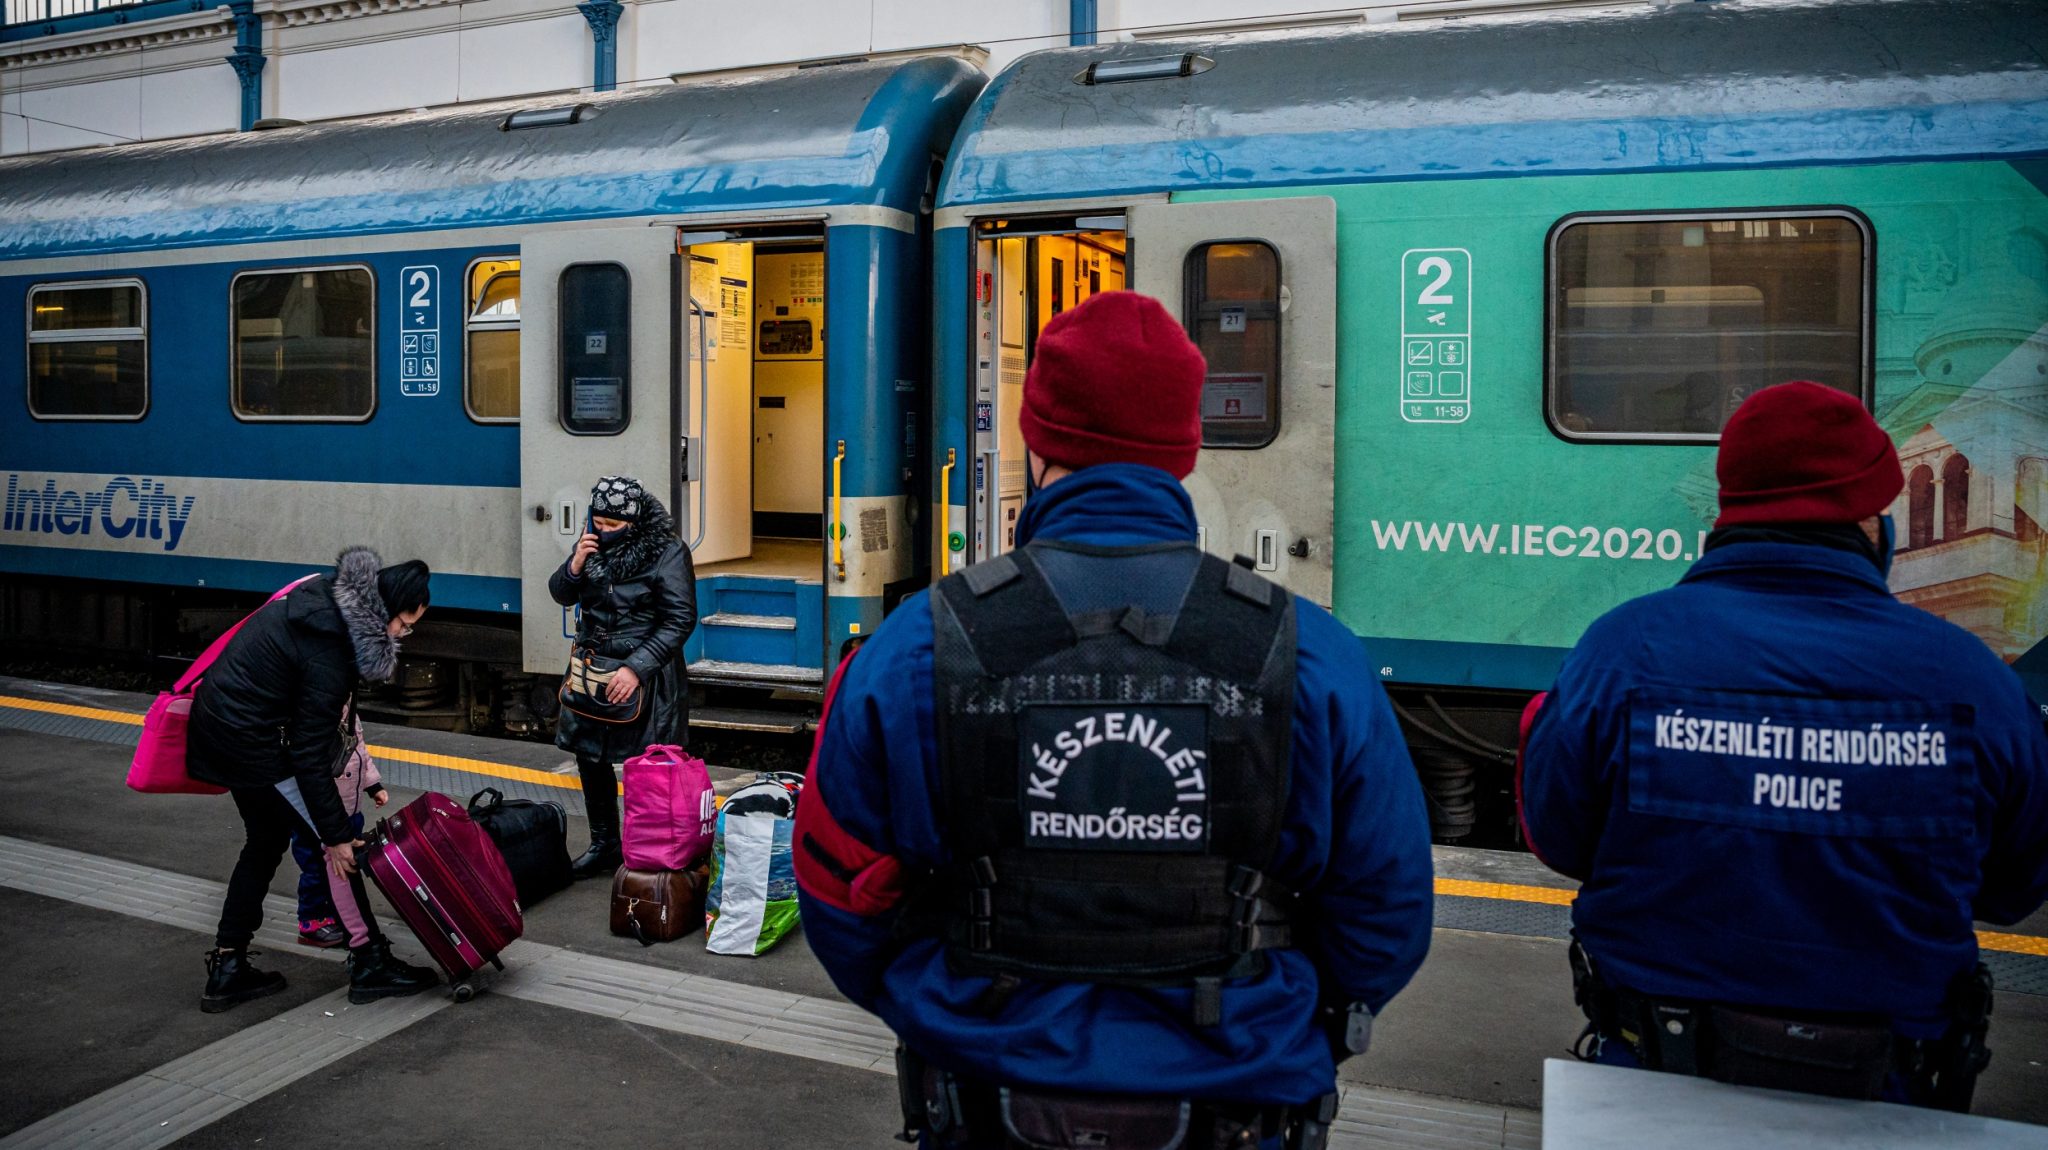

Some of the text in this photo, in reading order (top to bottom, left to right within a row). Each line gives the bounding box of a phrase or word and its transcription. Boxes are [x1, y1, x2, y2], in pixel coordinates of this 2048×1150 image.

[410, 270, 430, 307] 2
[1418, 256, 1453, 304] 2
[1226, 315, 1239, 325] 21
[590, 338, 602, 348] 22
[1435, 406, 1464, 417] 11-58
[4, 474, 196, 551] InterCity
[1380, 666, 1393, 676] 4R
[1655, 709, 1947, 766] KÉSZENLÉTI RENDŐRSÉG
[1027, 712, 1207, 801] KÉSZENLÉTI
[1753, 773, 1842, 811] POLICE
[1030, 806, 1204, 840] RENDŐRSÉG
